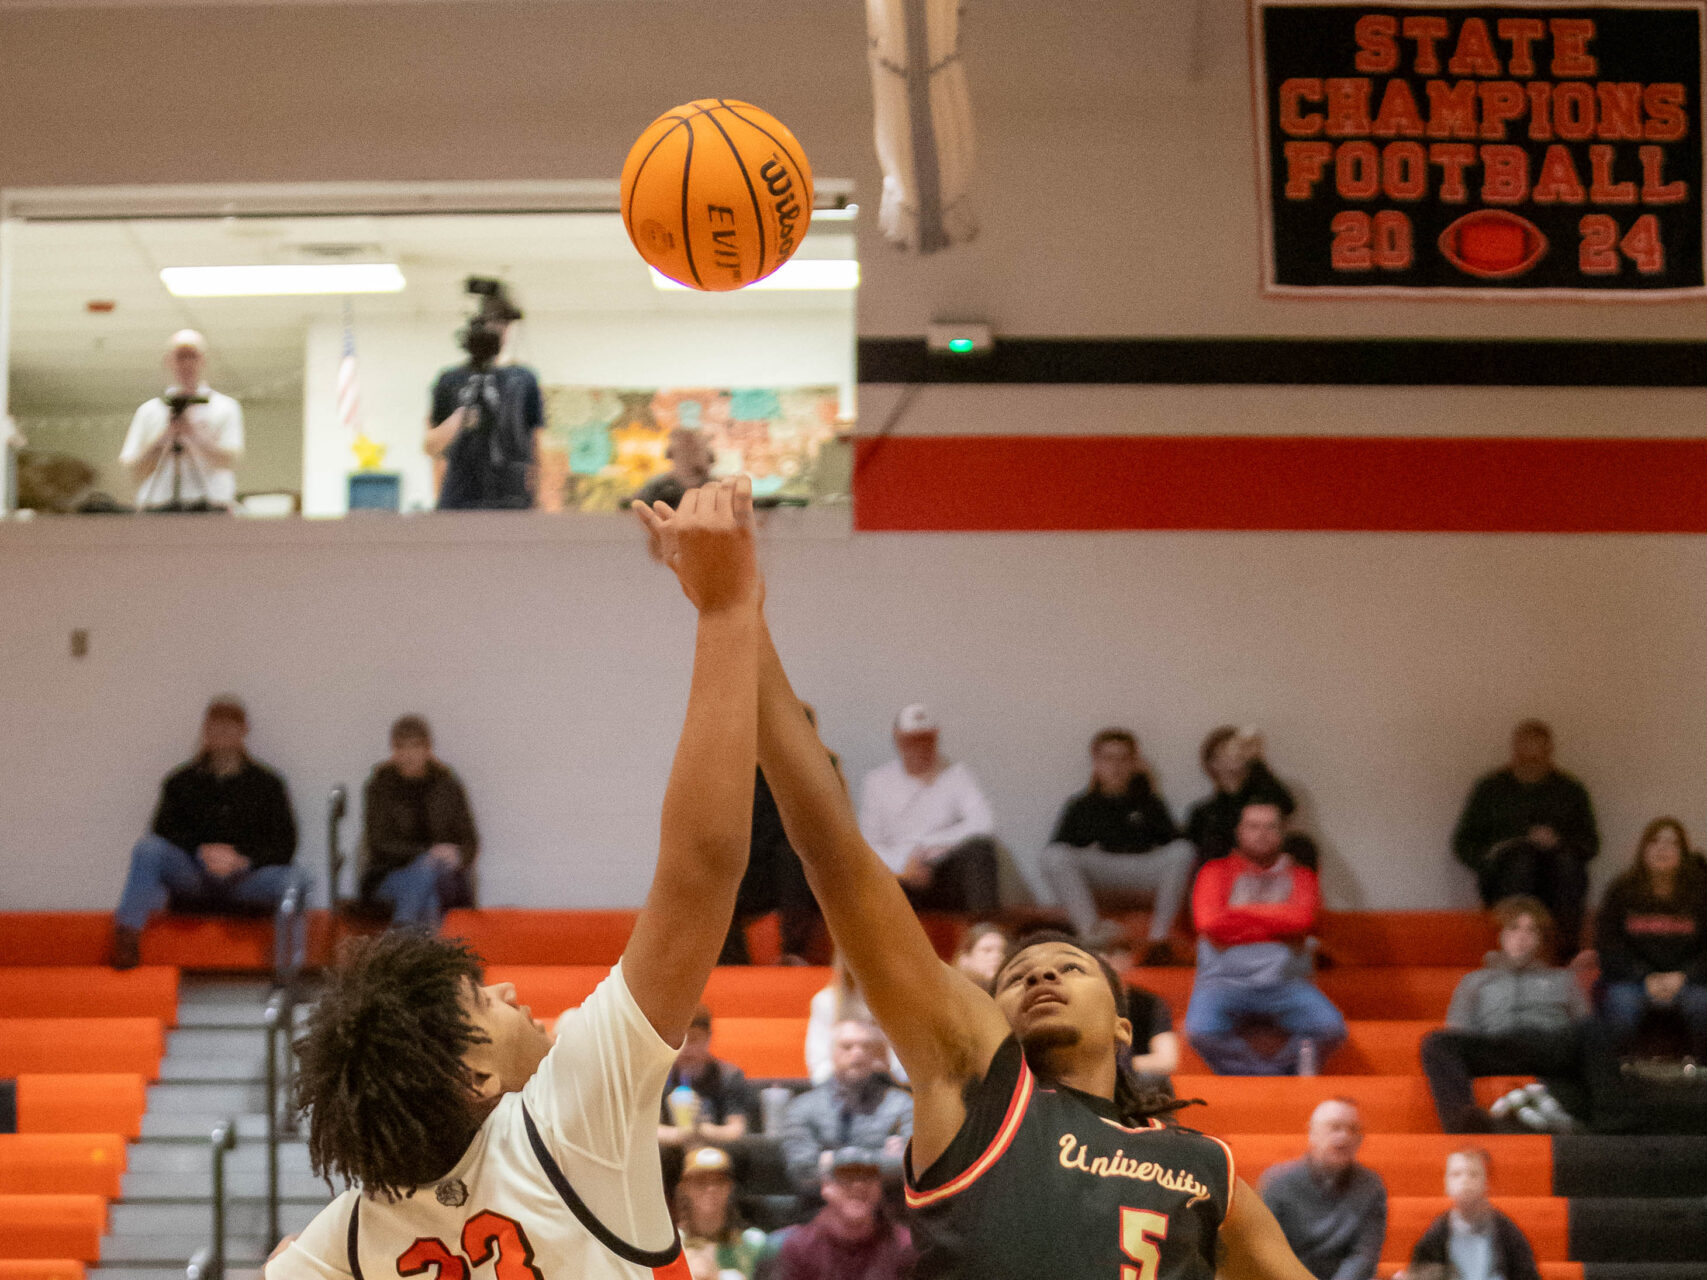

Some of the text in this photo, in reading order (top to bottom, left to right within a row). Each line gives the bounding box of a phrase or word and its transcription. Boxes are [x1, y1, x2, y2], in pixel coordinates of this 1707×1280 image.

[1354, 14, 1597, 77] STATE
[1279, 77, 1688, 140] CHAMPIONS
[1283, 141, 1688, 203] FOOTBALL
[1330, 210, 1664, 274] 20 24
[1059, 1133, 1210, 1209] University
